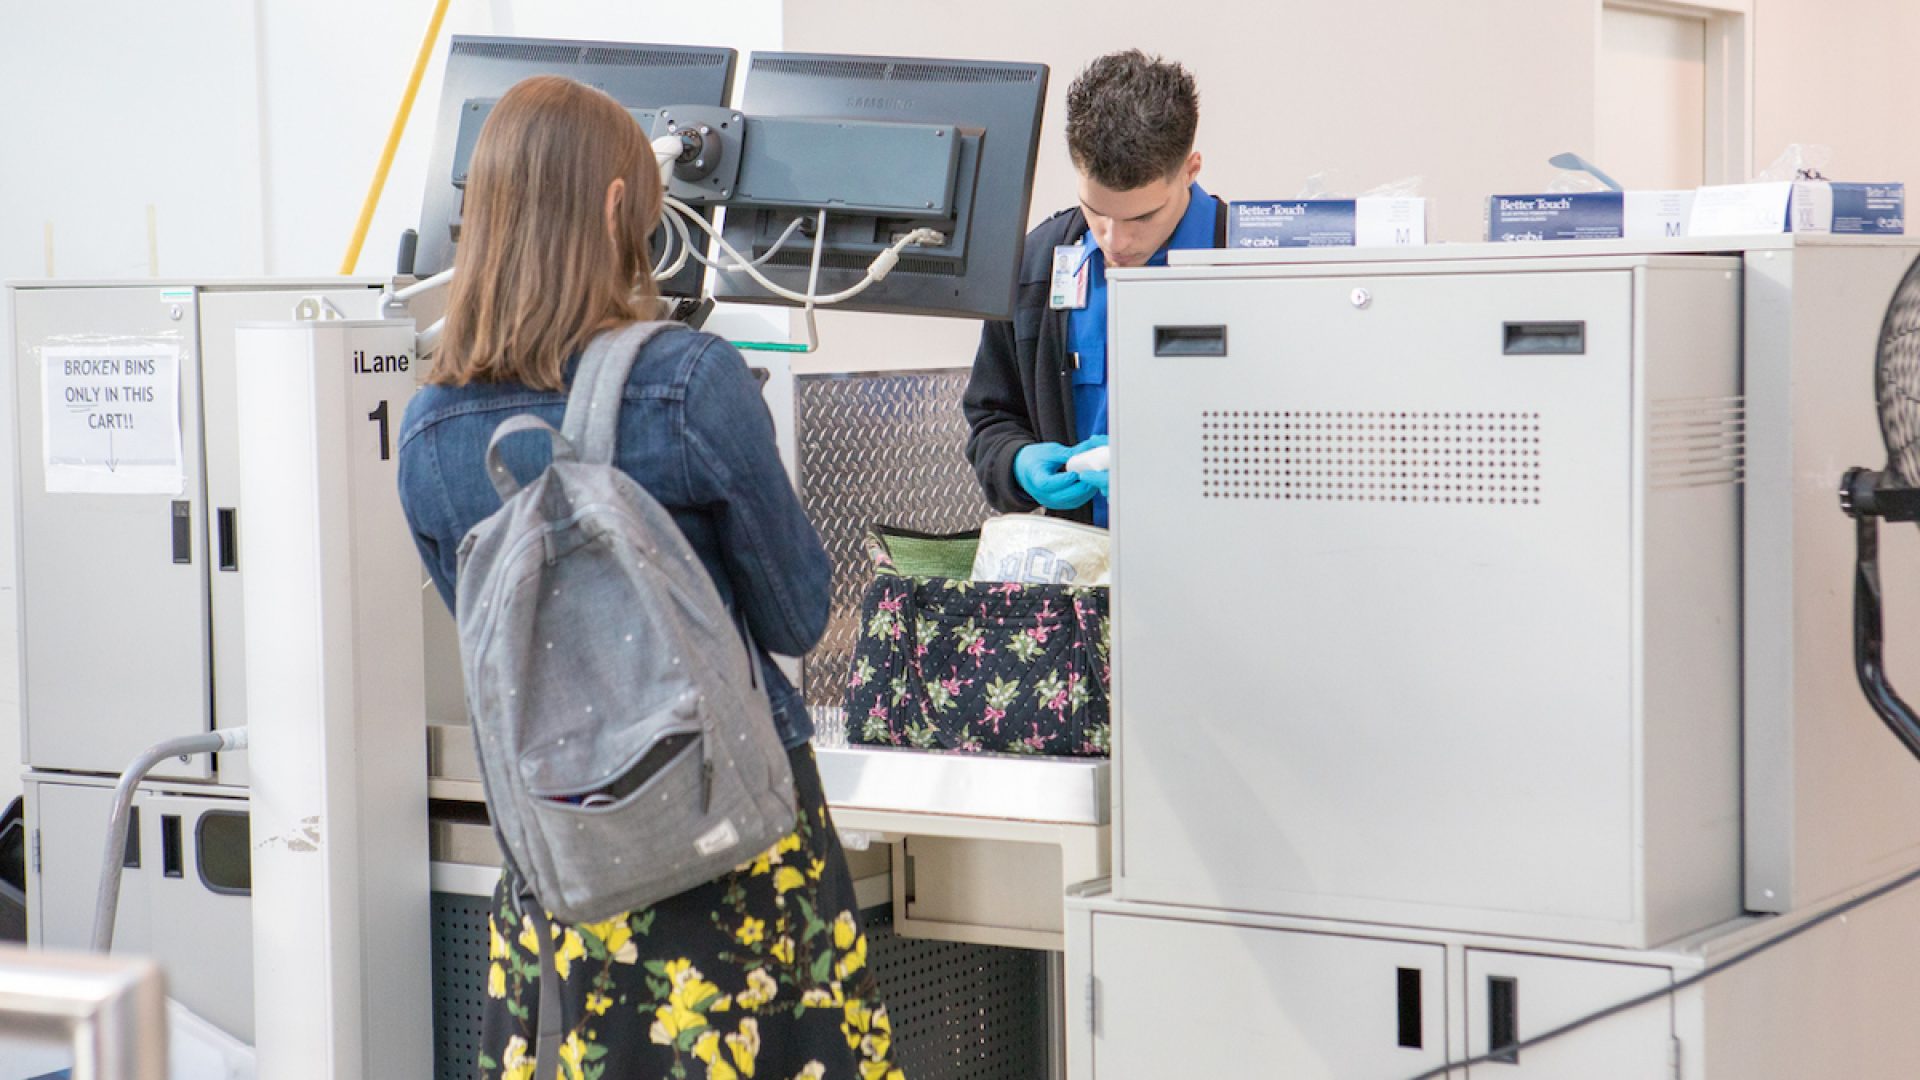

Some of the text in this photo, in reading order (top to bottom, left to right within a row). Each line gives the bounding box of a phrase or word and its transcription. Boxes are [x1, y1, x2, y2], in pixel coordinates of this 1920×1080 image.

[1239, 204, 1304, 215] Better Touch
[1500, 198, 1570, 210] Better Touch
[1396, 228, 1409, 244] M
[1665, 222, 1680, 237] M
[64, 360, 155, 375] BROKEN BINS
[353, 351, 409, 374] iLane
[65, 387, 154, 402] ONLY IN THIS
[88, 413, 134, 429] CART!!
[368, 400, 390, 460] 1
